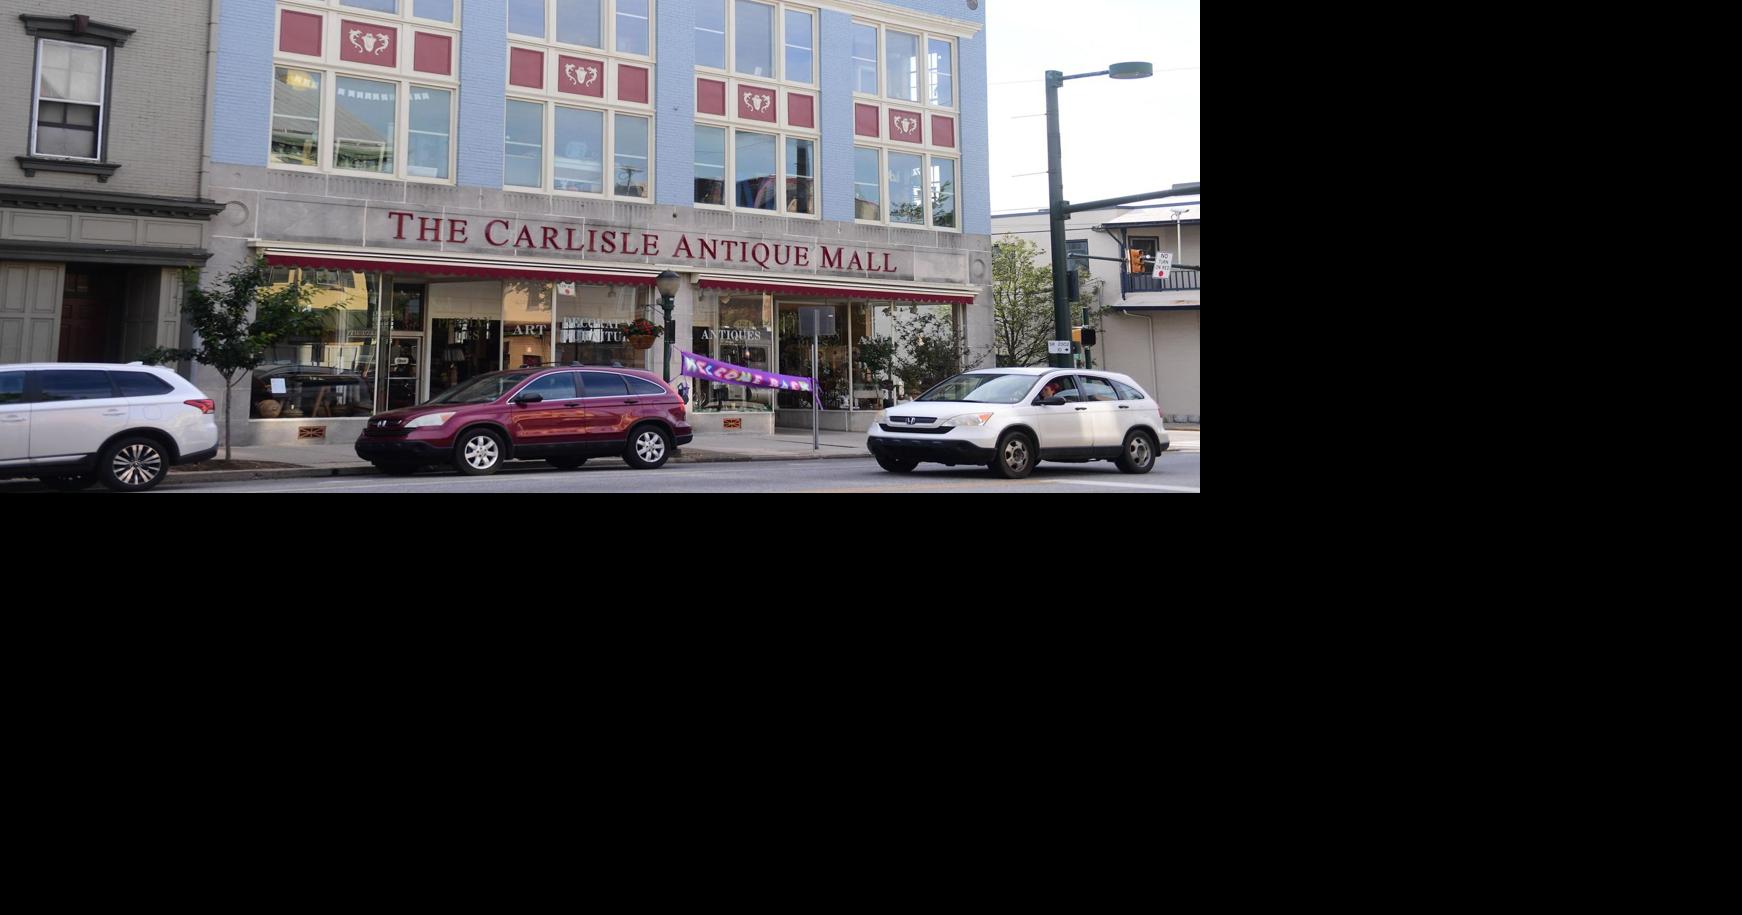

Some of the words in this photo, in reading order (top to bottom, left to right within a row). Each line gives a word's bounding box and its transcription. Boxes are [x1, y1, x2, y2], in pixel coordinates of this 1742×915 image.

[388, 211, 468, 244] THE
[484, 219, 660, 256] CARLISLE
[672, 234, 809, 269] ANTIQUE
[820, 245, 897, 273] MALL
[512, 324, 547, 336] ART
[701, 329, 761, 341] ANTIQUES
[683, 356, 763, 384] WELCOME
